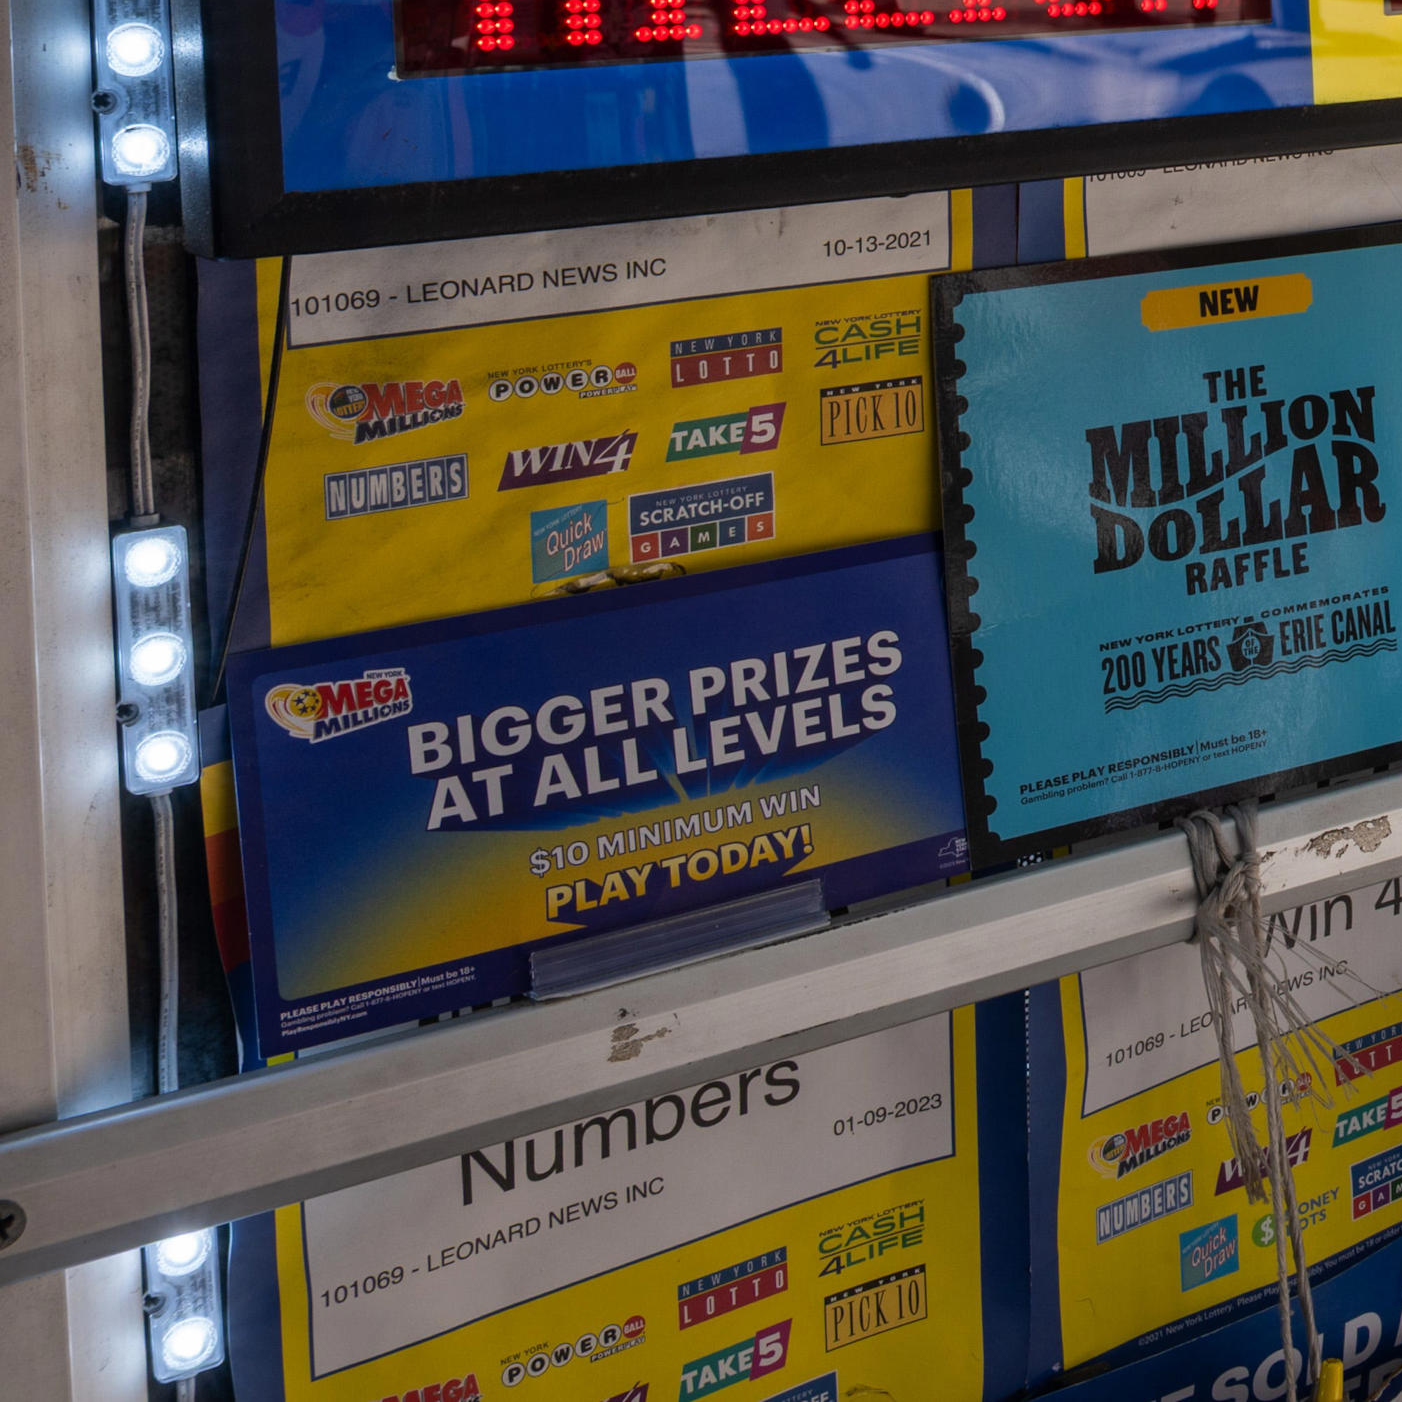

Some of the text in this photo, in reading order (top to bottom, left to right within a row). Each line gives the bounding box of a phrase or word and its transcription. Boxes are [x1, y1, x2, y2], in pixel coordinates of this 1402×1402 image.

[822, 229, 931, 258] 10-13-2021
[289, 256, 667, 318] 101069 LEONARD NEWS INC
[1199, 284, 1260, 318] NEW
[814, 315, 921, 345] CASH
[814, 338, 920, 369] 4LIFE
[676, 350, 779, 383] LOTTO
[1202, 363, 1267, 403] THE
[354, 404, 465, 445] MILLIONS
[359, 379, 465, 422] MEGA
[828, 389, 918, 438] PICK 10
[1084, 385, 1376, 509] MILLION
[329, 461, 463, 513] NUMBERS
[639, 492, 766, 527] SCRATCH-OFF
[1090, 439, 1387, 575] DOLLAR
[546, 512, 593, 557] Quick
[564, 530, 605, 572] Draw
[1185, 542, 1310, 596] RAFFLE
[1099, 585, 1390, 653] NEW YORK LOTTERY COMMEMORATES
[1101, 650, 1147, 695] 200
[1151, 635, 1222, 683] YEARS
[1279, 612, 1328, 657] ERIE
[1331, 600, 1397, 646] CANAL
[313, 700, 410, 741] MILLIONS
[315, 678, 409, 720] MEGA
[407, 629, 902, 775] BIGGER PRIZES
[426, 683, 898, 831] AT ALL LEVELS
[1019, 728, 1268, 796] PLEASE PLAY RESPONSIBLY Must be 18+
[1020, 787, 1066, 807] Gambling
[1067, 778, 1110, 797] problem?
[1111, 772, 1128, 785] Call
[1213, 748, 1230, 760] text
[1231, 738, 1268, 755] HOPENY
[530, 783, 823, 878] $10 MINIMUM WIN
[545, 823, 815, 919] PLAY TODAY!
[279, 965, 476, 1021] PLEASE PLAY RESPONSIBLY Must be 18+
[459, 1060, 802, 1206] Numbers
[832, 1092, 944, 1137] 01-09-2023
[1121, 1111, 1192, 1161] MEGA
[1116, 1129, 1192, 1180] MILLIONS
[818, 1205, 924, 1255] CASH
[1100, 1180, 1191, 1239] NUMBERS
[320, 1175, 666, 1308] 101069 LEONARD NEWS INC
[818, 1228, 924, 1278] 4LIFE
[683, 1268, 785, 1325] LOTTO
[832, 1279, 920, 1343] PICK 10
